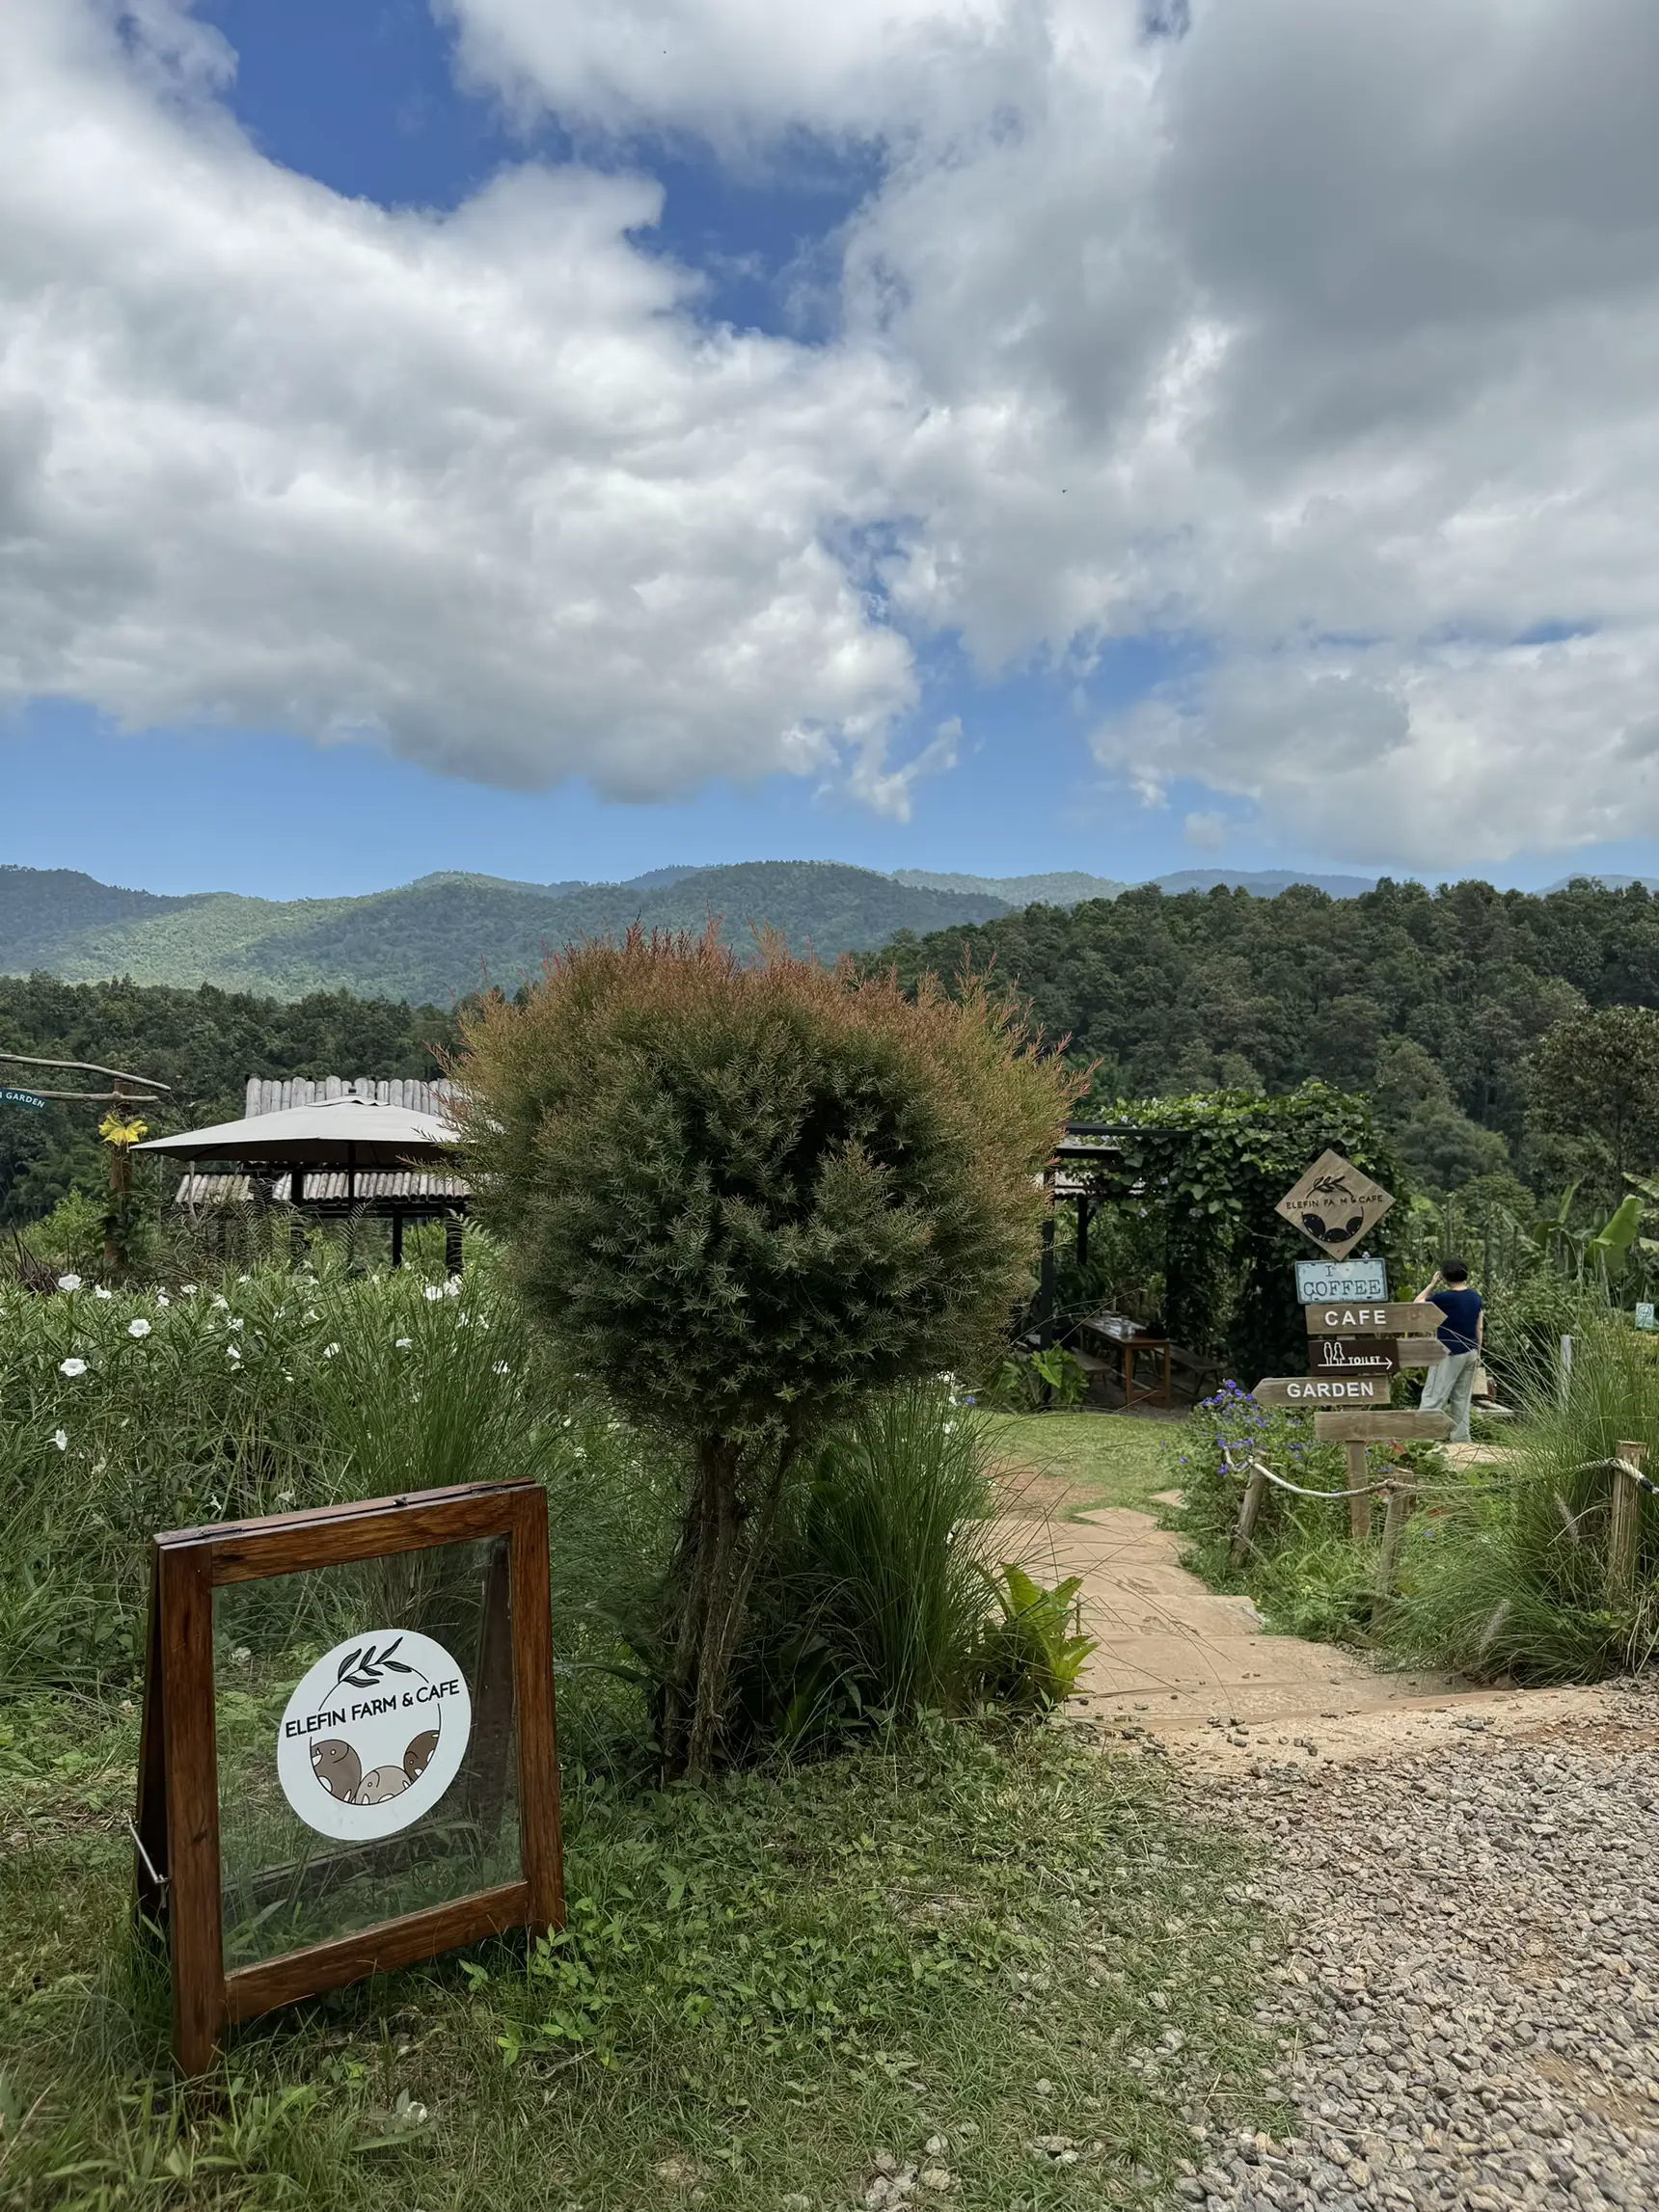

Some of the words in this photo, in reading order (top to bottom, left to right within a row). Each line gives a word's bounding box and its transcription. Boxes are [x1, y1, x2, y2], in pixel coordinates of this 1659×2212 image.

[6, 1092, 45, 1108] GARDEN
[1286, 1200, 1319, 1210] ELEFIN
[1323, 1197, 1347, 1207] FAM
[1358, 1194, 1383, 1204] CAFE
[1324, 1265, 1333, 1277] I
[1303, 1279, 1381, 1297] COFFEE
[1324, 1309, 1387, 1326] CAFE
[1347, 1356, 1381, 1364] TOILET
[1287, 1381, 1373, 1398] GARDEN
[286, 1708, 347, 1739] ELEFIN
[351, 1694, 397, 1721] FARM
[402, 1692, 414, 1708] &
[416, 1678, 460, 1705] CAFE
